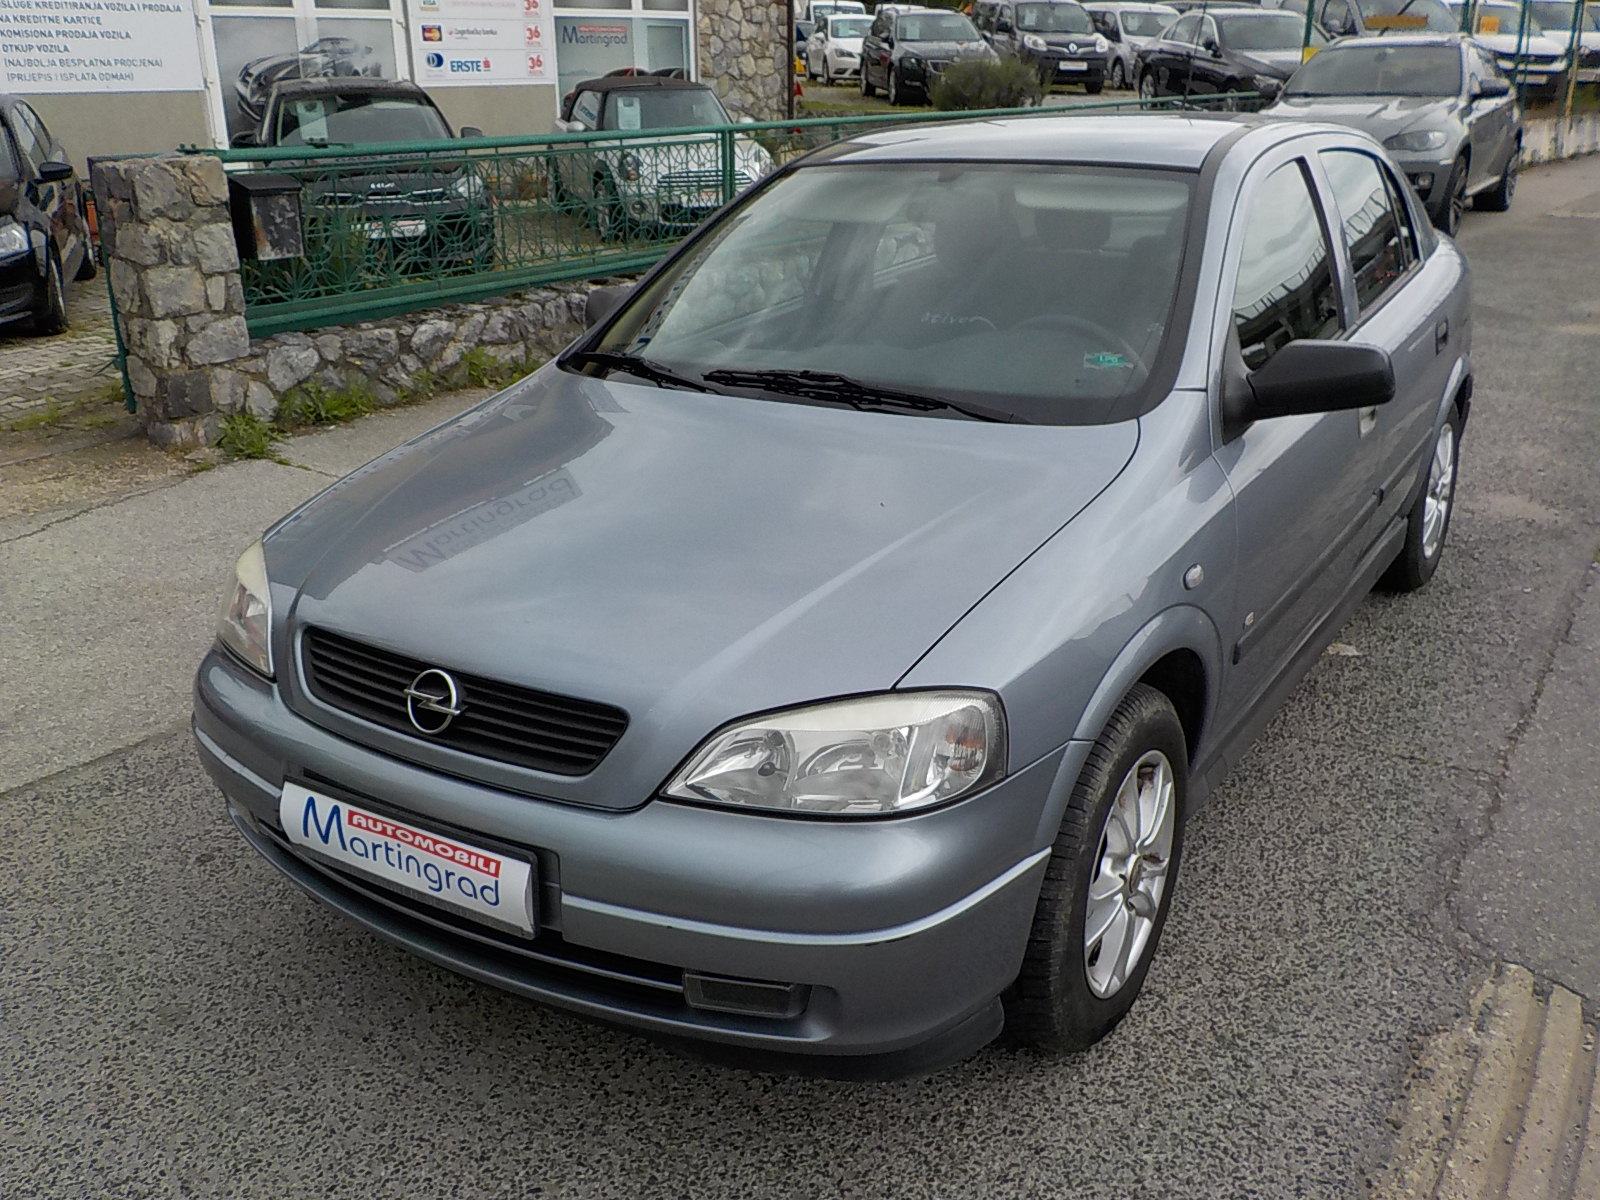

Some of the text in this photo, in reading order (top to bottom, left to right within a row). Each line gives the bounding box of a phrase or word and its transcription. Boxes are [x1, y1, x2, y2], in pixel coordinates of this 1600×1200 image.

[35, 1, 103, 11] KREDITIRANJA
[104, 3, 136, 12] VOZILA
[142, 4, 182, 13] PRODAJA
[12, 14, 61, 25] KREDITNE
[62, 15, 102, 26] KARTICE
[0, 29, 132, 40] KOMISIONA PRODAJA VOZILA
[526, 25, 541, 41] 36
[562, 25, 628, 48] Martingrad
[2, 43, 70, 53] OTKUP VOZILA
[59, 58, 113, 68] BESPLATNA
[449, 60, 482, 73] ERSTE
[528, 54, 543, 70] 36
[351, 813, 498, 874] AUTOMOBILI
[302, 796, 500, 907] Martingrad
